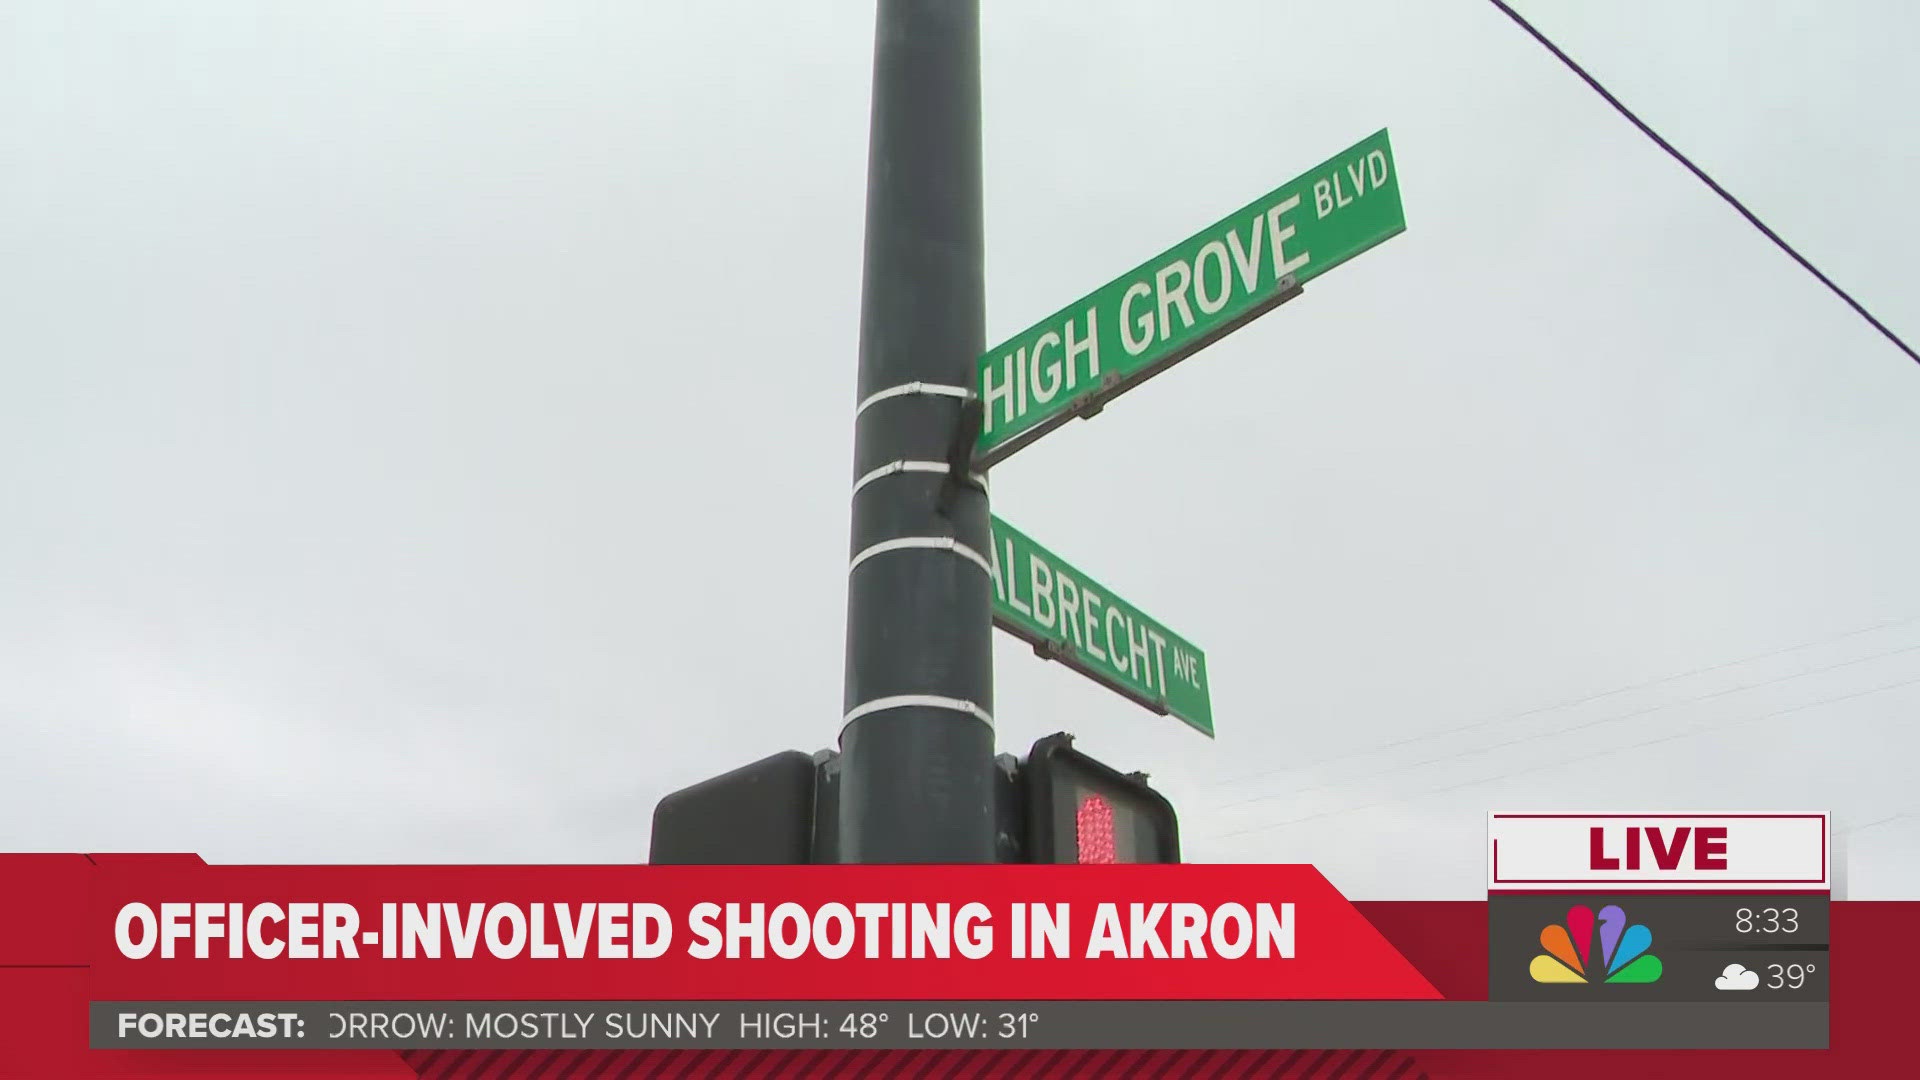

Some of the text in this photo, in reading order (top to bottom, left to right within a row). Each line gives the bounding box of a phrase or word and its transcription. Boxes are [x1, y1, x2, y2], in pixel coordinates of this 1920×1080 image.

[982, 149, 1389, 433] HIGH GROVE BLVD
[1173, 648, 1201, 690] AVE
